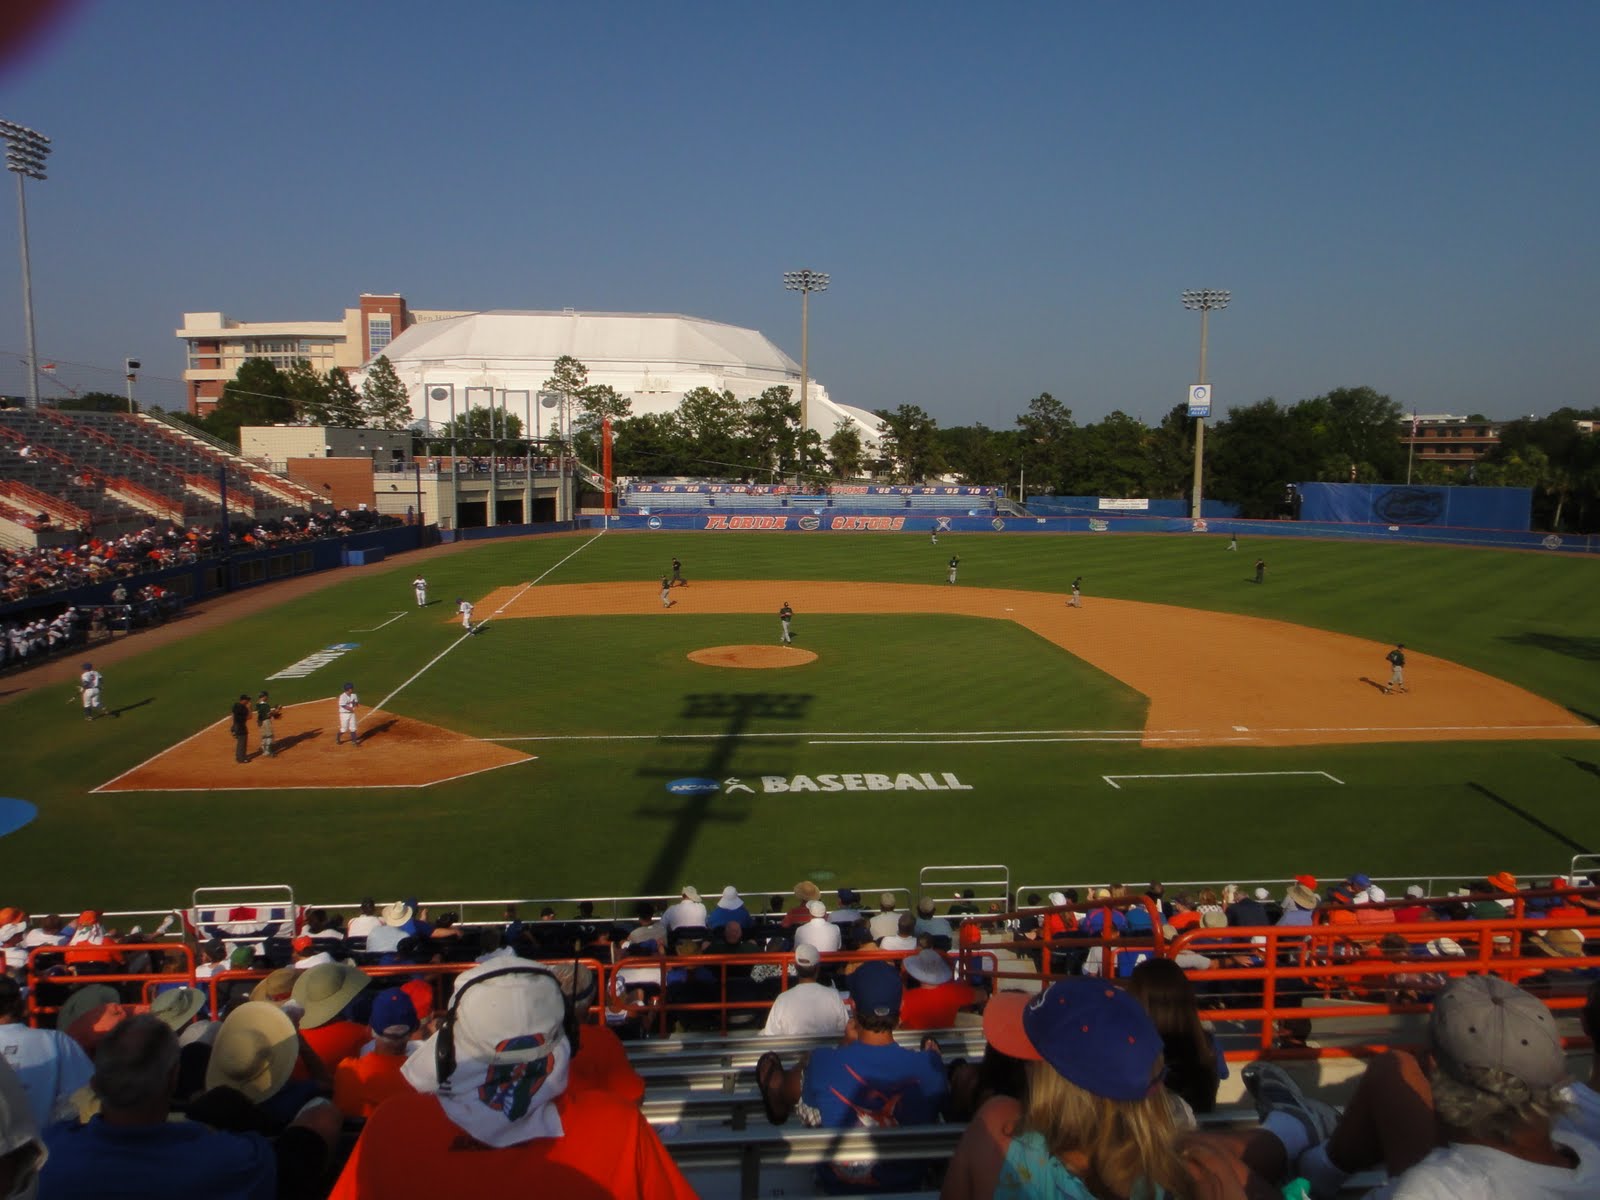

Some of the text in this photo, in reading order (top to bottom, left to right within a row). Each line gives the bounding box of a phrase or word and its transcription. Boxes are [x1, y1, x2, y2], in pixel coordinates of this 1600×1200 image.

[704, 516, 905, 531] FLORIDA GATORS
[761, 773, 973, 793] BASEBALL
